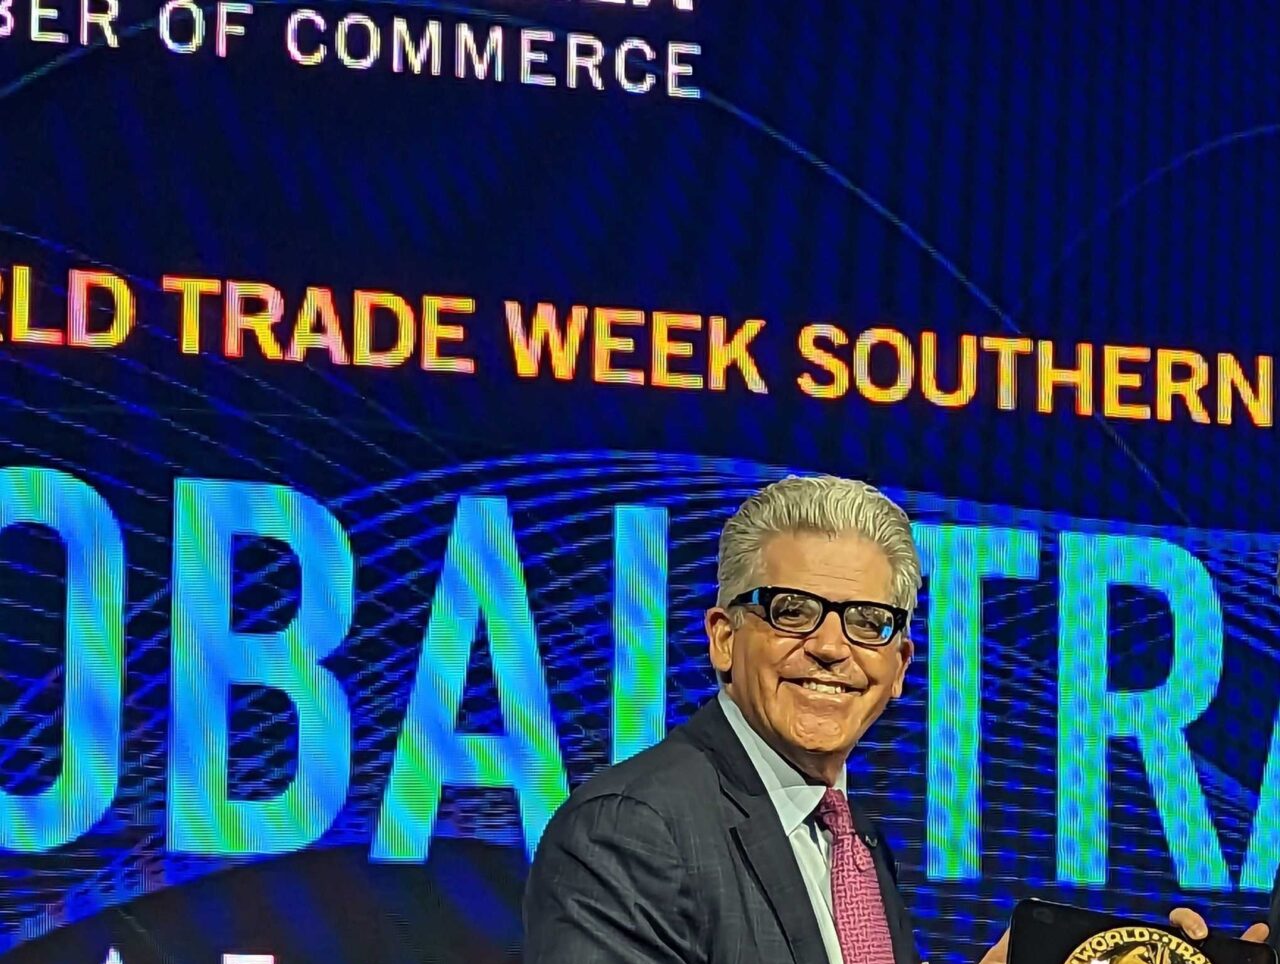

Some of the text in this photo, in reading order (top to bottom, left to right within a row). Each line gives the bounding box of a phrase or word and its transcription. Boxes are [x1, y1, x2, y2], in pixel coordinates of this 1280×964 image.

[159, 0, 253, 57] OF
[287, 8, 702, 98] COMMERCE
[0, 264, 136, 348] LD
[162, 274, 476, 374] TRADE
[504, 299, 768, 394] WEEK
[796, 322, 1274, 429] SOUTHERN
[1076, 929, 1150, 962] WORLD
